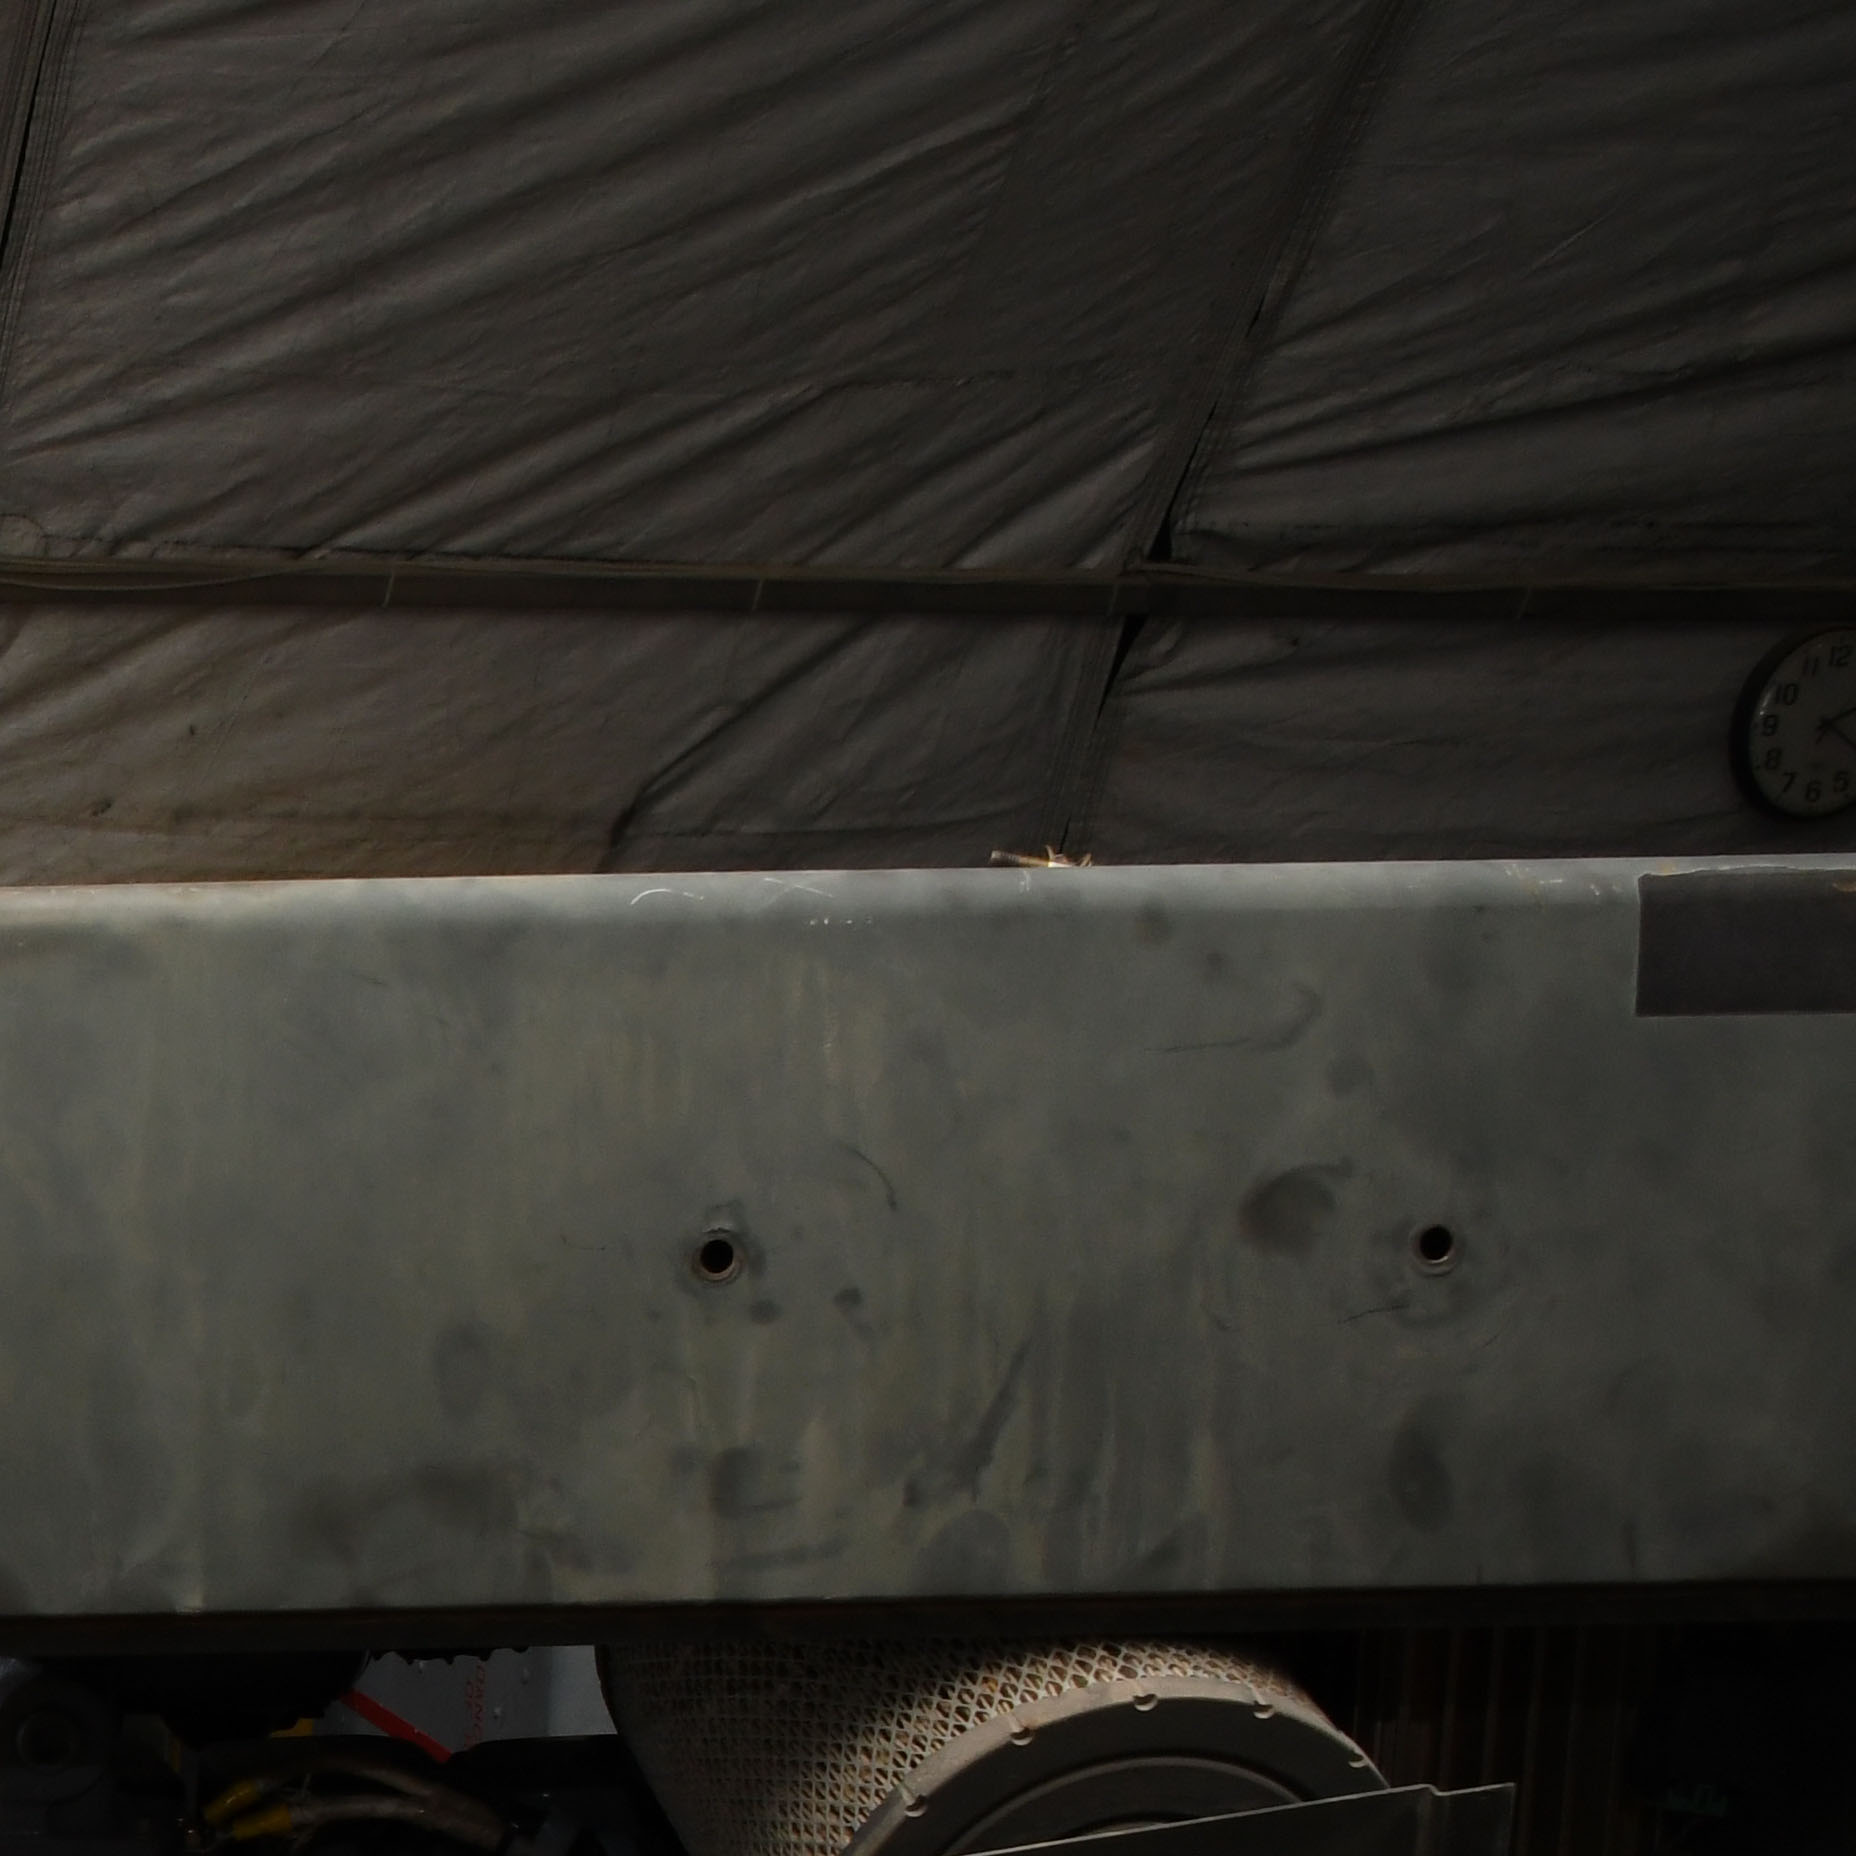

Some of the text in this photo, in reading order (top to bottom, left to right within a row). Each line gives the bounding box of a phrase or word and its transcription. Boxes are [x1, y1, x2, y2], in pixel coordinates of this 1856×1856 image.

[1801, 655, 1820, 677] 11
[1828, 643, 1854, 668] 12
[1774, 682, 1800, 706] 10
[1761, 714, 1779, 737] 9
[1764, 746, 1783, 771] 8
[1781, 771, 1798, 794] 7
[1805, 779, 1822, 803] 6
[1832, 769, 1850, 793] 5
